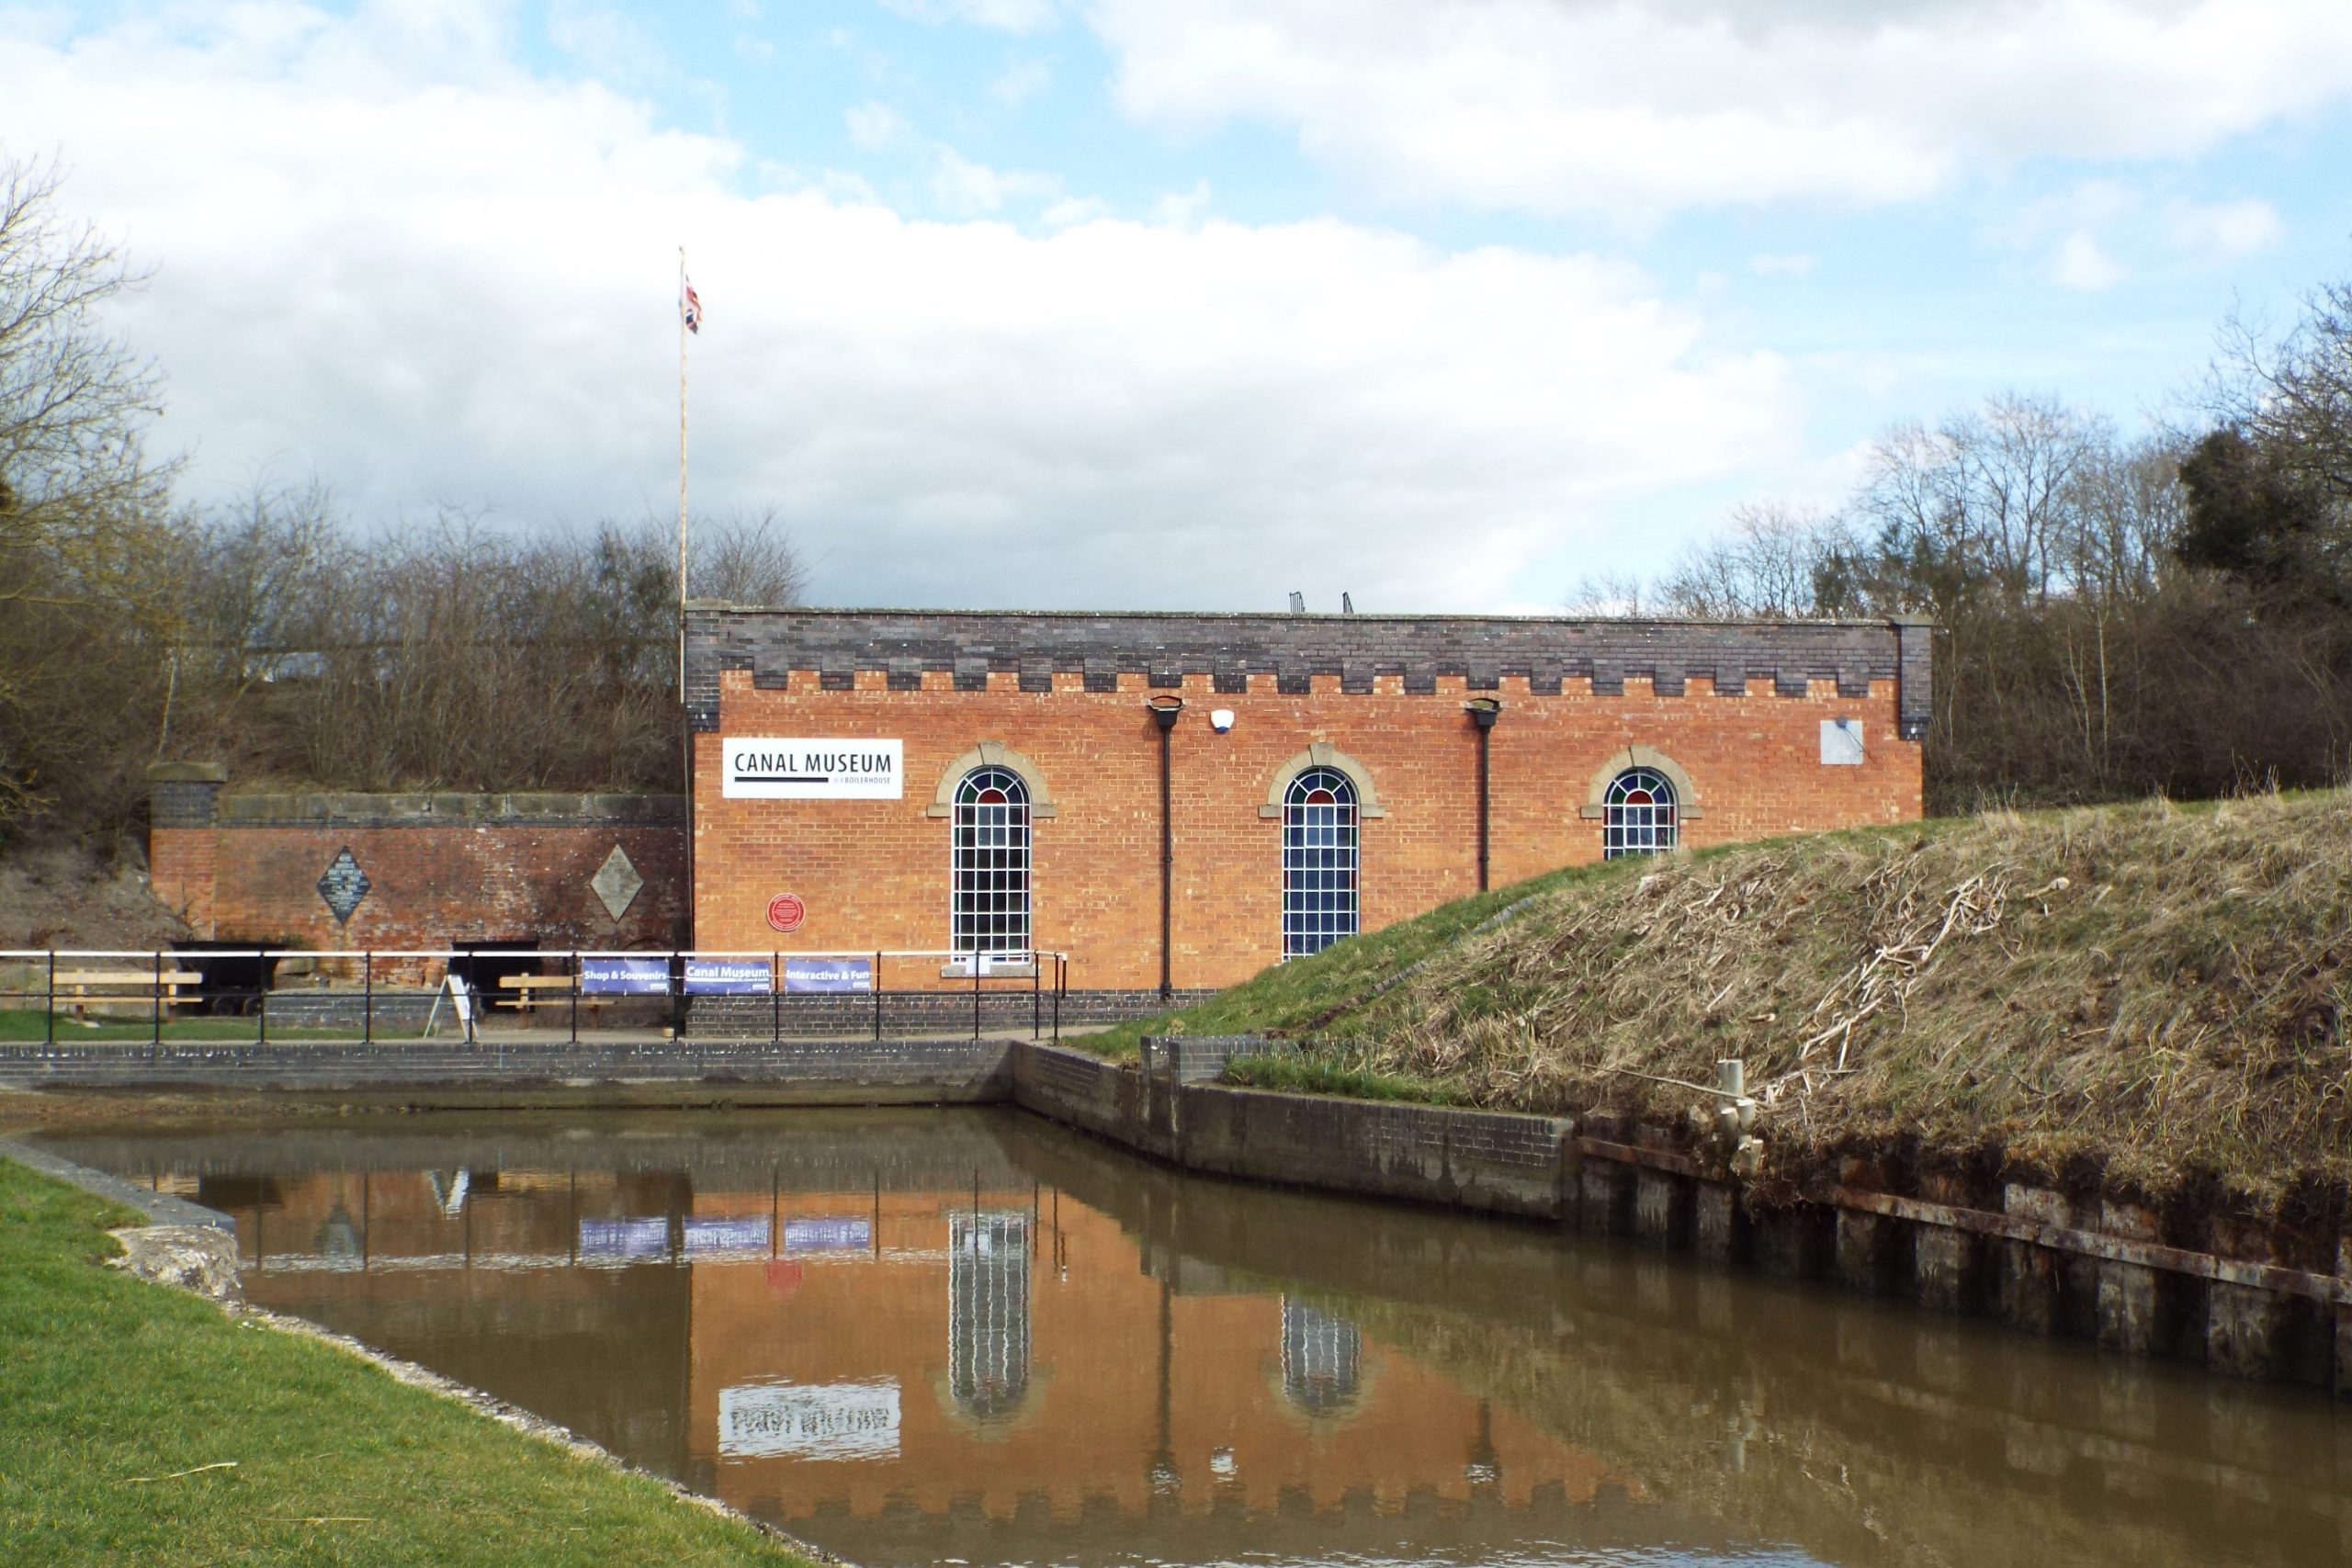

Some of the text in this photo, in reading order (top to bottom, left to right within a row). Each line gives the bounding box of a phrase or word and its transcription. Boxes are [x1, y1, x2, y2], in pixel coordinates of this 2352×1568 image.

[734, 752, 892, 773] CANAL MUSEUM
[844, 776, 891, 784] BOILERHOUSE
[584, 970, 667, 982] Shop & Souvenirs
[685, 965, 770, 978] Canal Museum
[786, 969, 870, 981] Interactive & Fun
